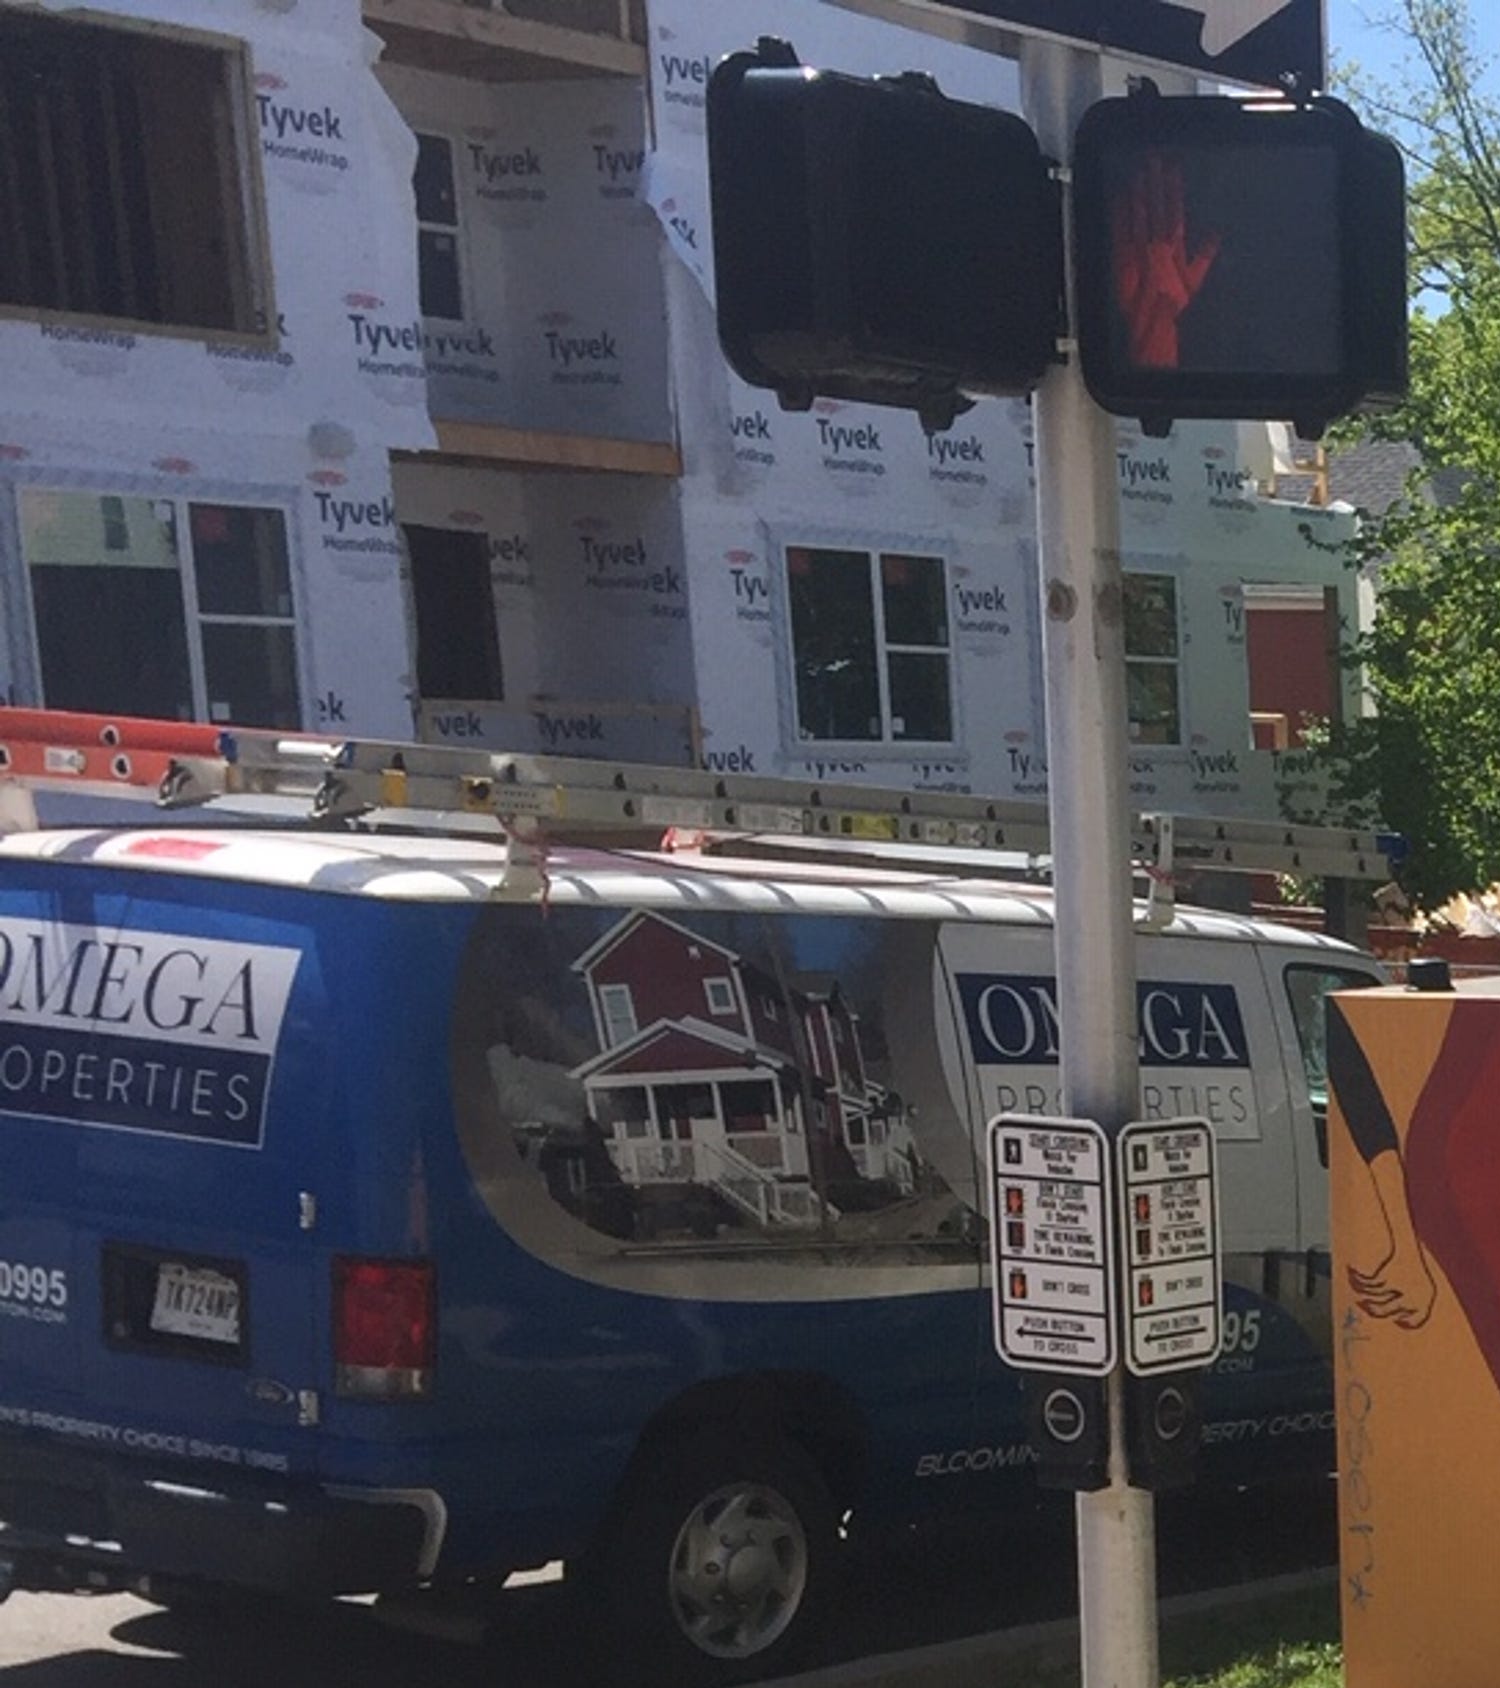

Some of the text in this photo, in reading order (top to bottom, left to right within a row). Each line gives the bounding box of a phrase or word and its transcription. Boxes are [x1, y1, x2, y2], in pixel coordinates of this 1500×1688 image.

[255, 94, 344, 139] Tyvek
[263, 141, 348, 170] HomeWrap
[468, 144, 541, 181] Tyvek
[545, 331, 616, 366] Tyvek
[730, 412, 771, 439] vek
[817, 418, 882, 453] Tyvek
[925, 432, 985, 465] Tyvek
[1116, 454, 1171, 486] Tyvek
[954, 583, 1007, 615] yvek
[0, 931, 260, 1040] MEGA
[0, 1262, 67, 1306] 0995
[1222, 1310, 1261, 1352] 95
[122, 1428, 187, 1454] CHOICE
